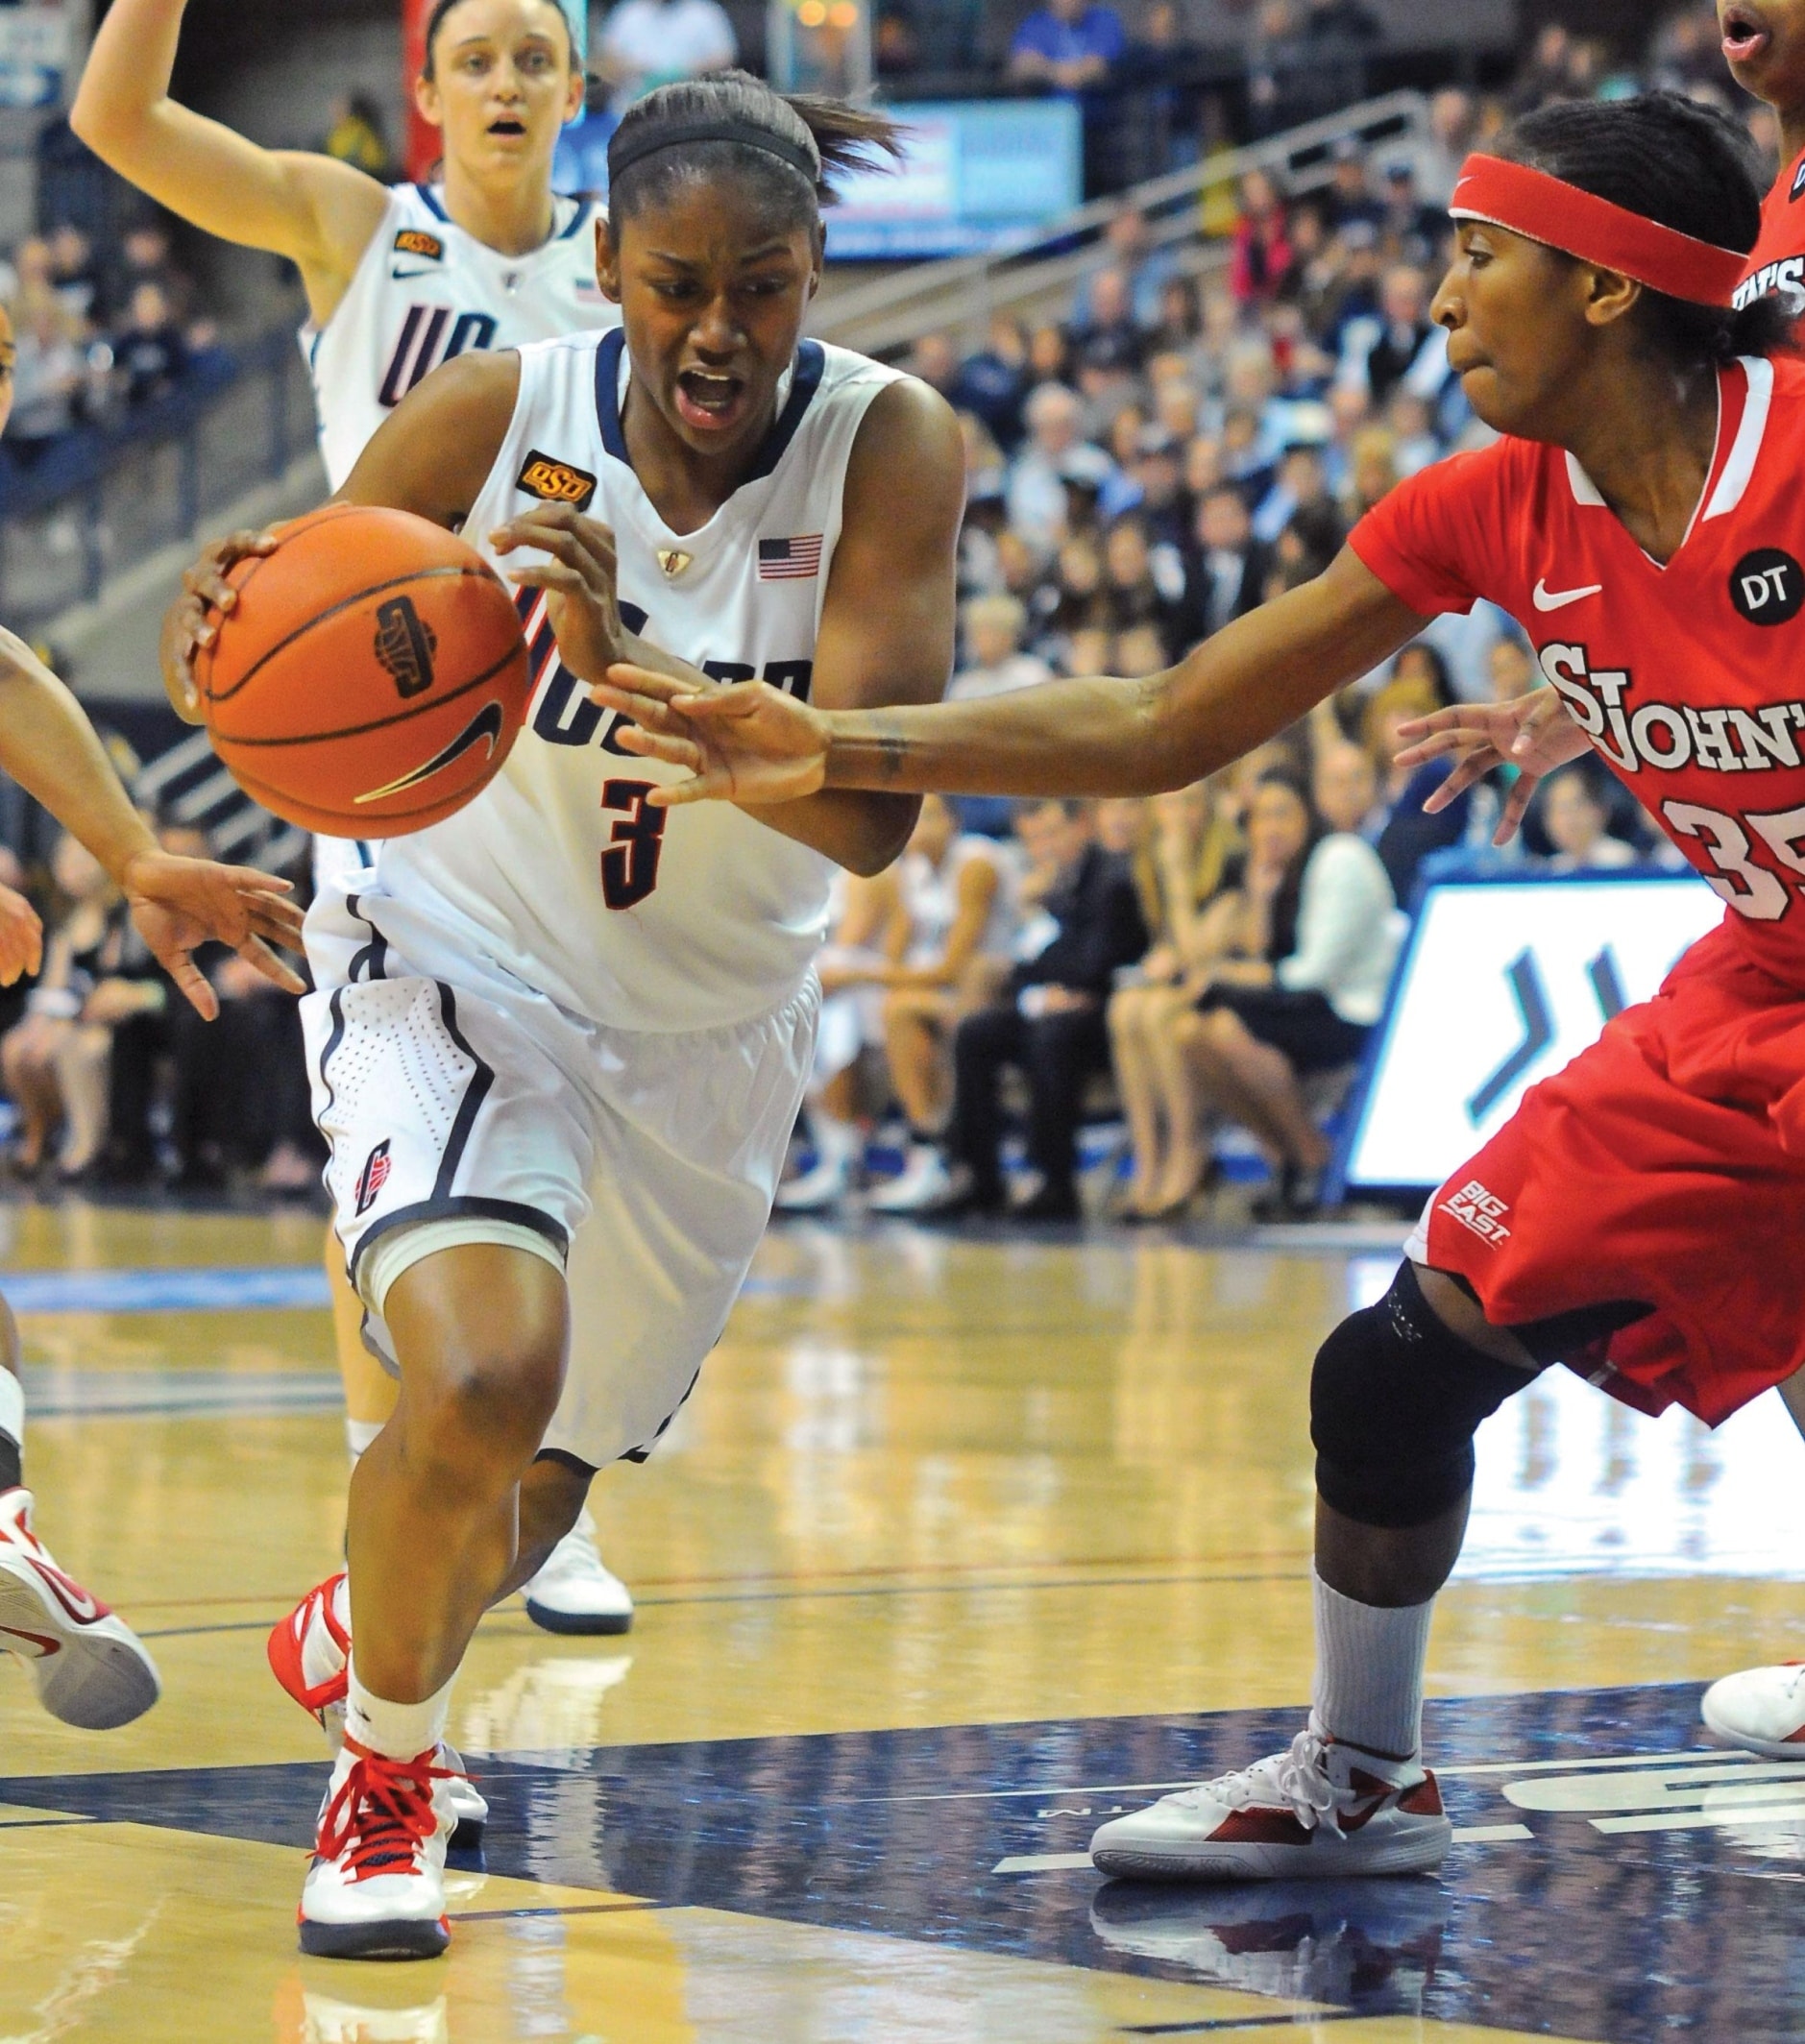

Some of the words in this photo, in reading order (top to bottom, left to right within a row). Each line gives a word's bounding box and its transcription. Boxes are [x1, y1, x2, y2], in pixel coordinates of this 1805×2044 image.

[1740, 565, 1789, 610] DT
[600, 779, 670, 911] 3
[1447, 1192, 1511, 1242] EAST
[1460, 1180, 1509, 1218] BIG
